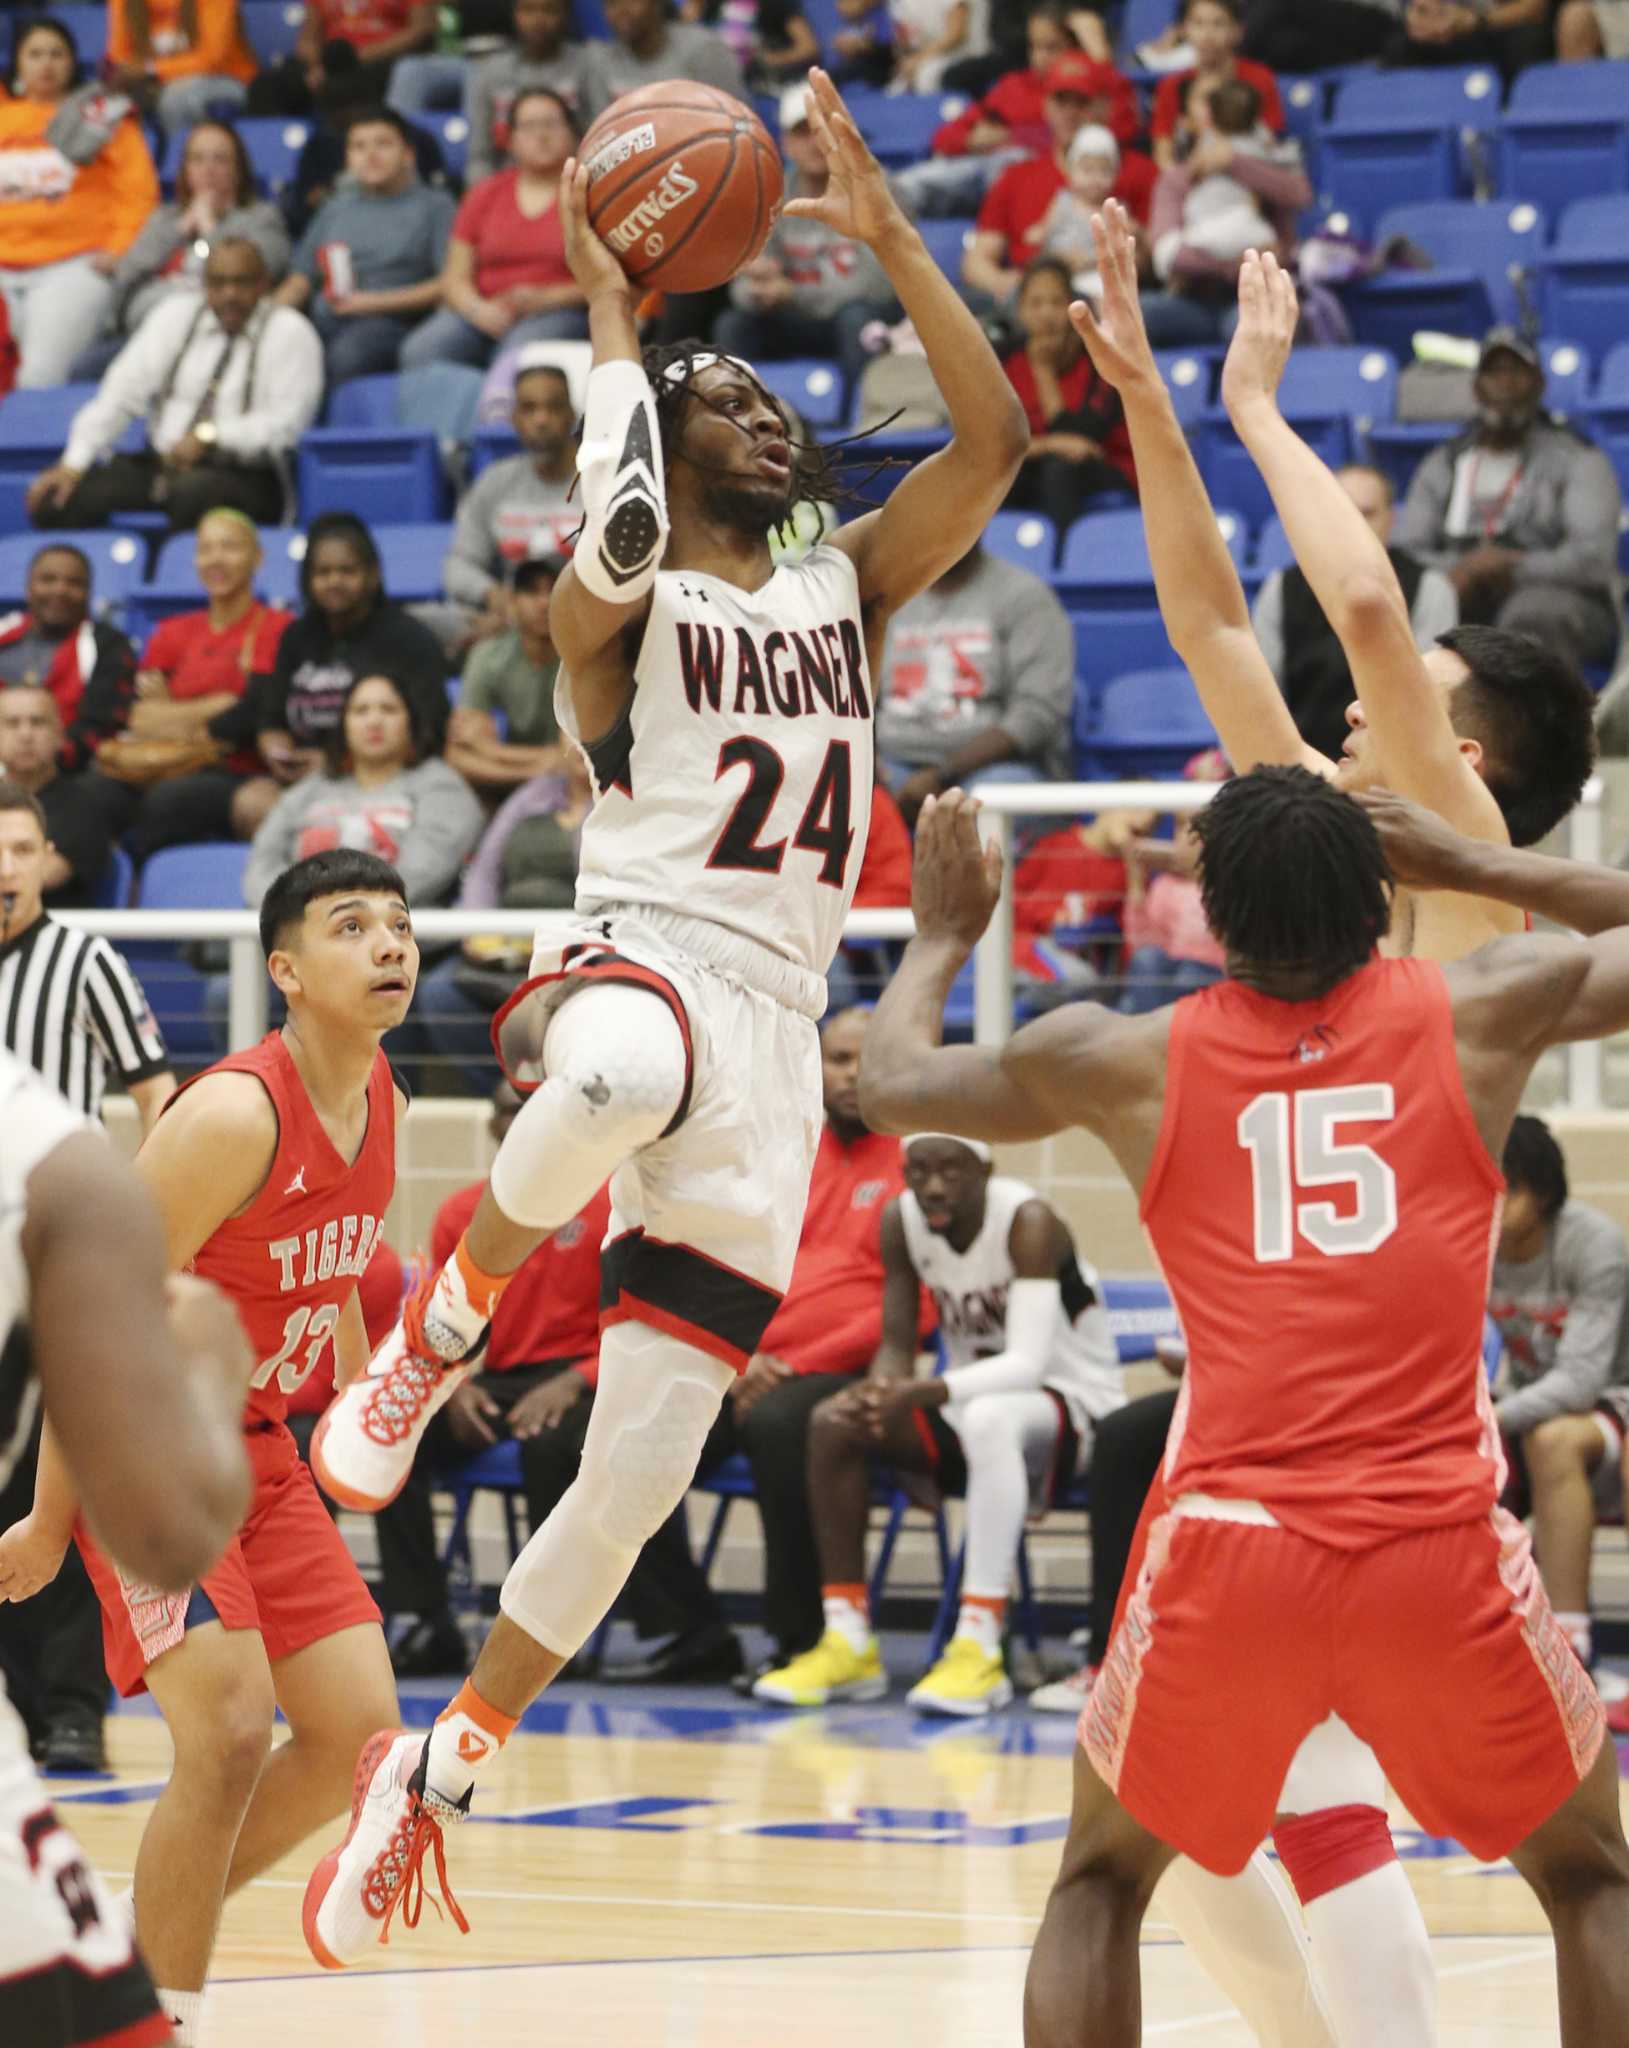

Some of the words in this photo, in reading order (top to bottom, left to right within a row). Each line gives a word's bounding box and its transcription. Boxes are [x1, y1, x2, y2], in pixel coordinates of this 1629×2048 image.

[676, 618, 871, 719] WAGNER
[704, 734, 855, 890] 24
[1237, 1082, 1398, 1263] 15
[250, 1303, 340, 1395] 13
